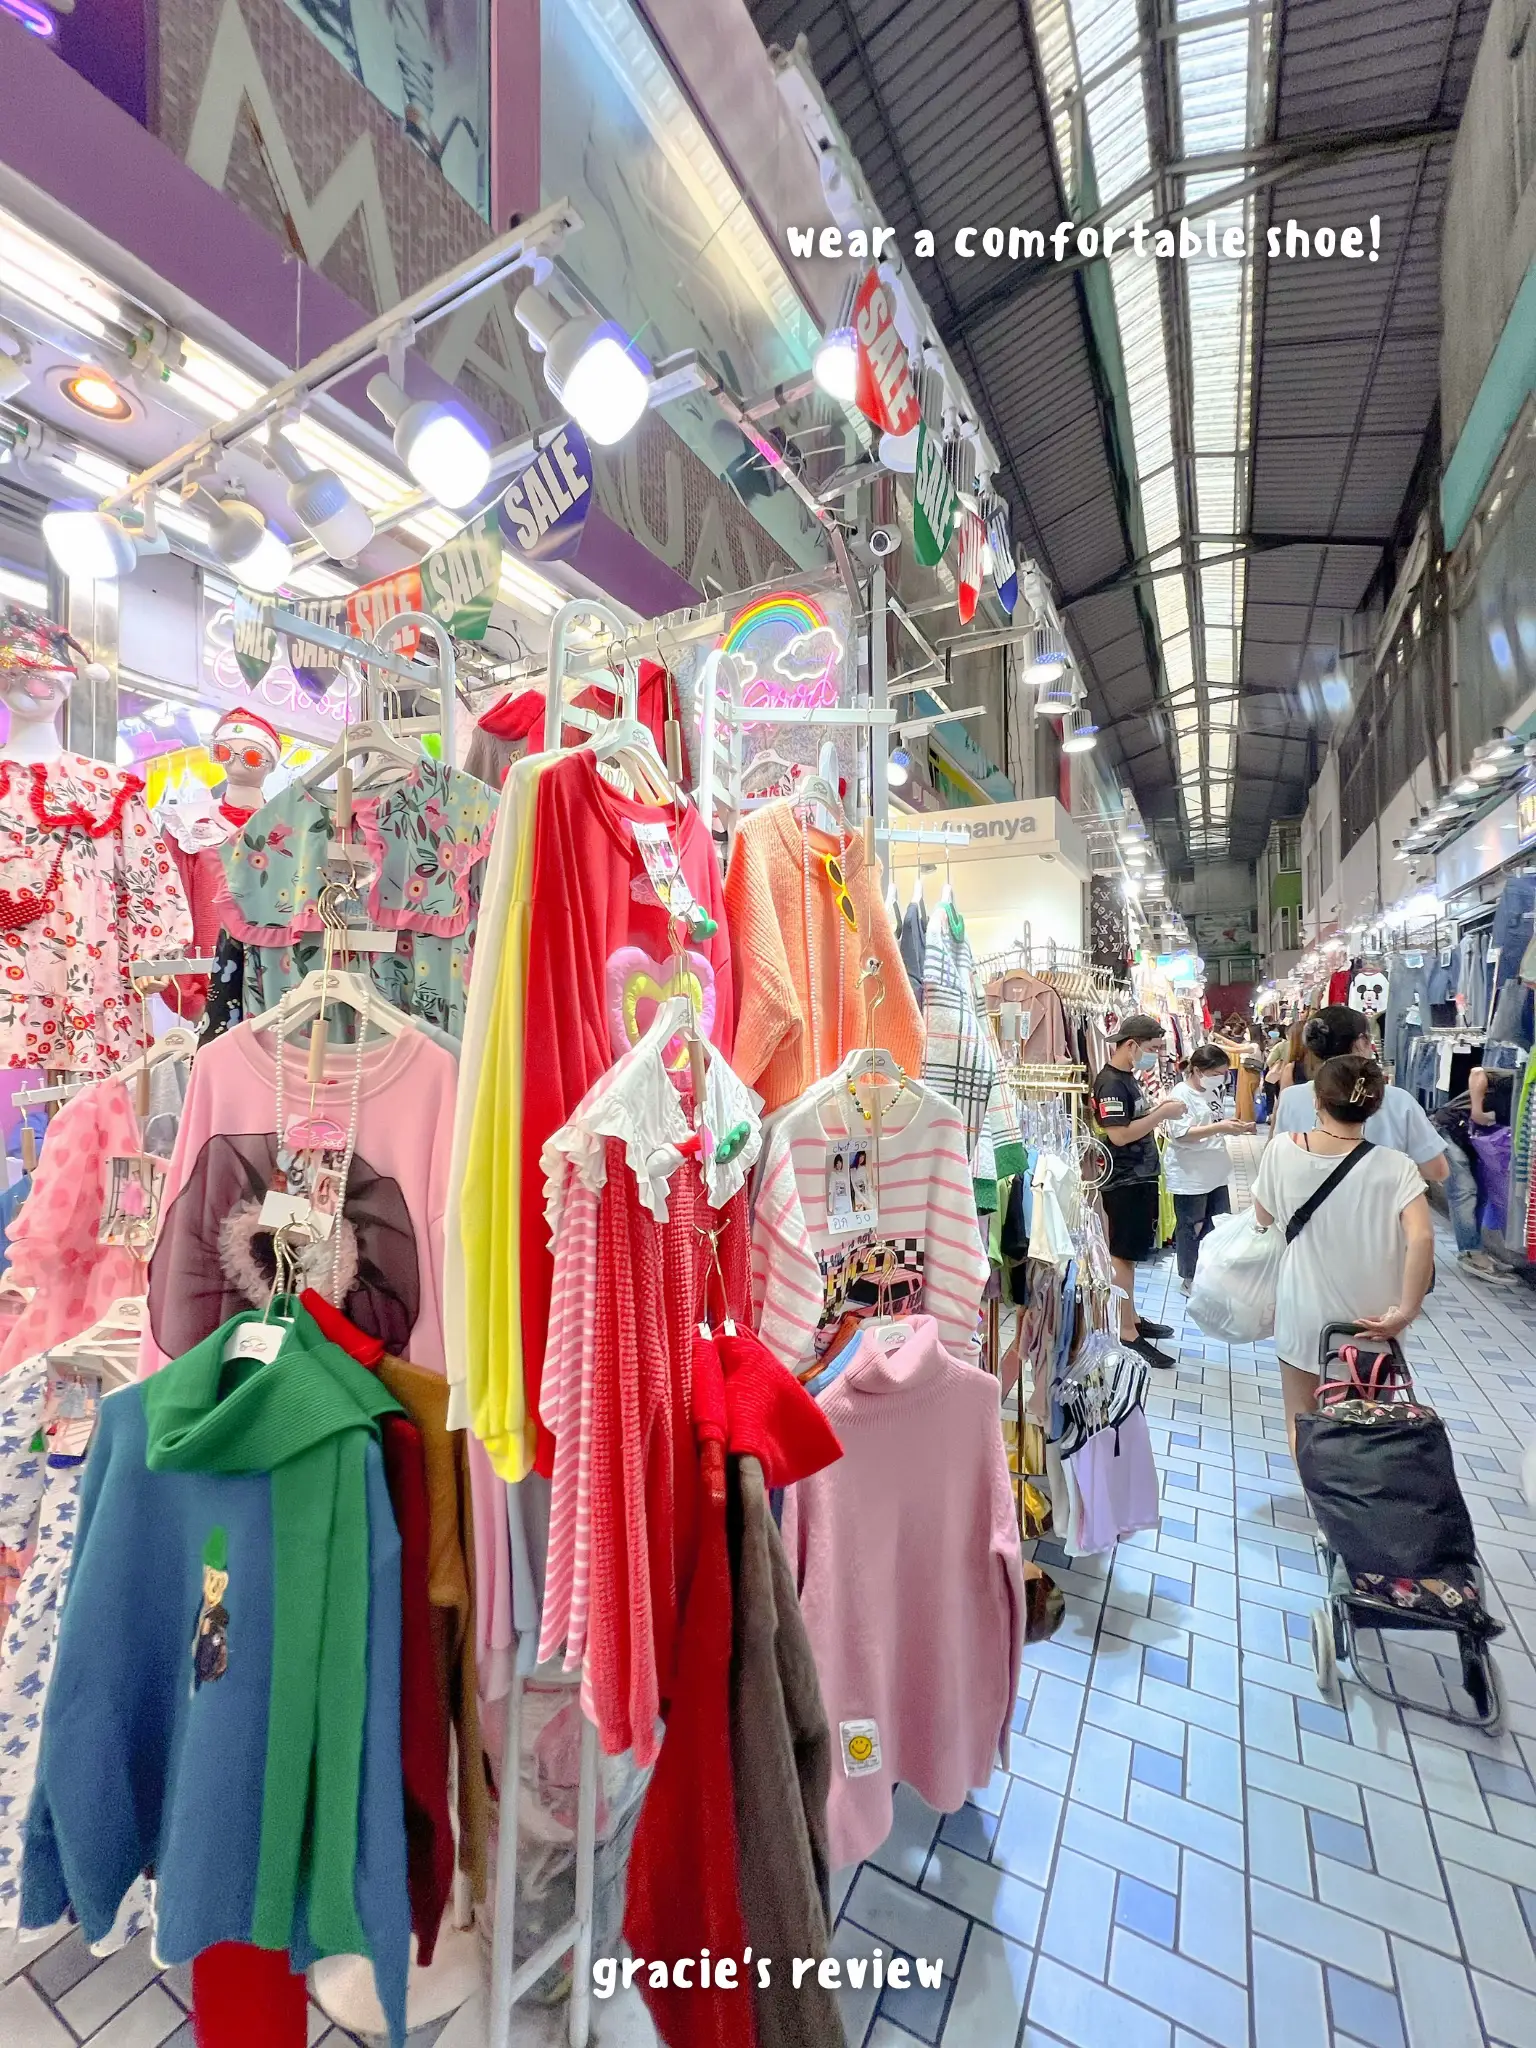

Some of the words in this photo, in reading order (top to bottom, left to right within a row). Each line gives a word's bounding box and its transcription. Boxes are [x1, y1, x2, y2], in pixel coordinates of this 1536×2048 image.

[857, 288, 918, 431] SALE
[503, 431, 590, 550] SALE
[429, 514, 498, 624] SALE
[854, 1140, 868, 1151] 50
[855, 1213, 871, 1225] 50
